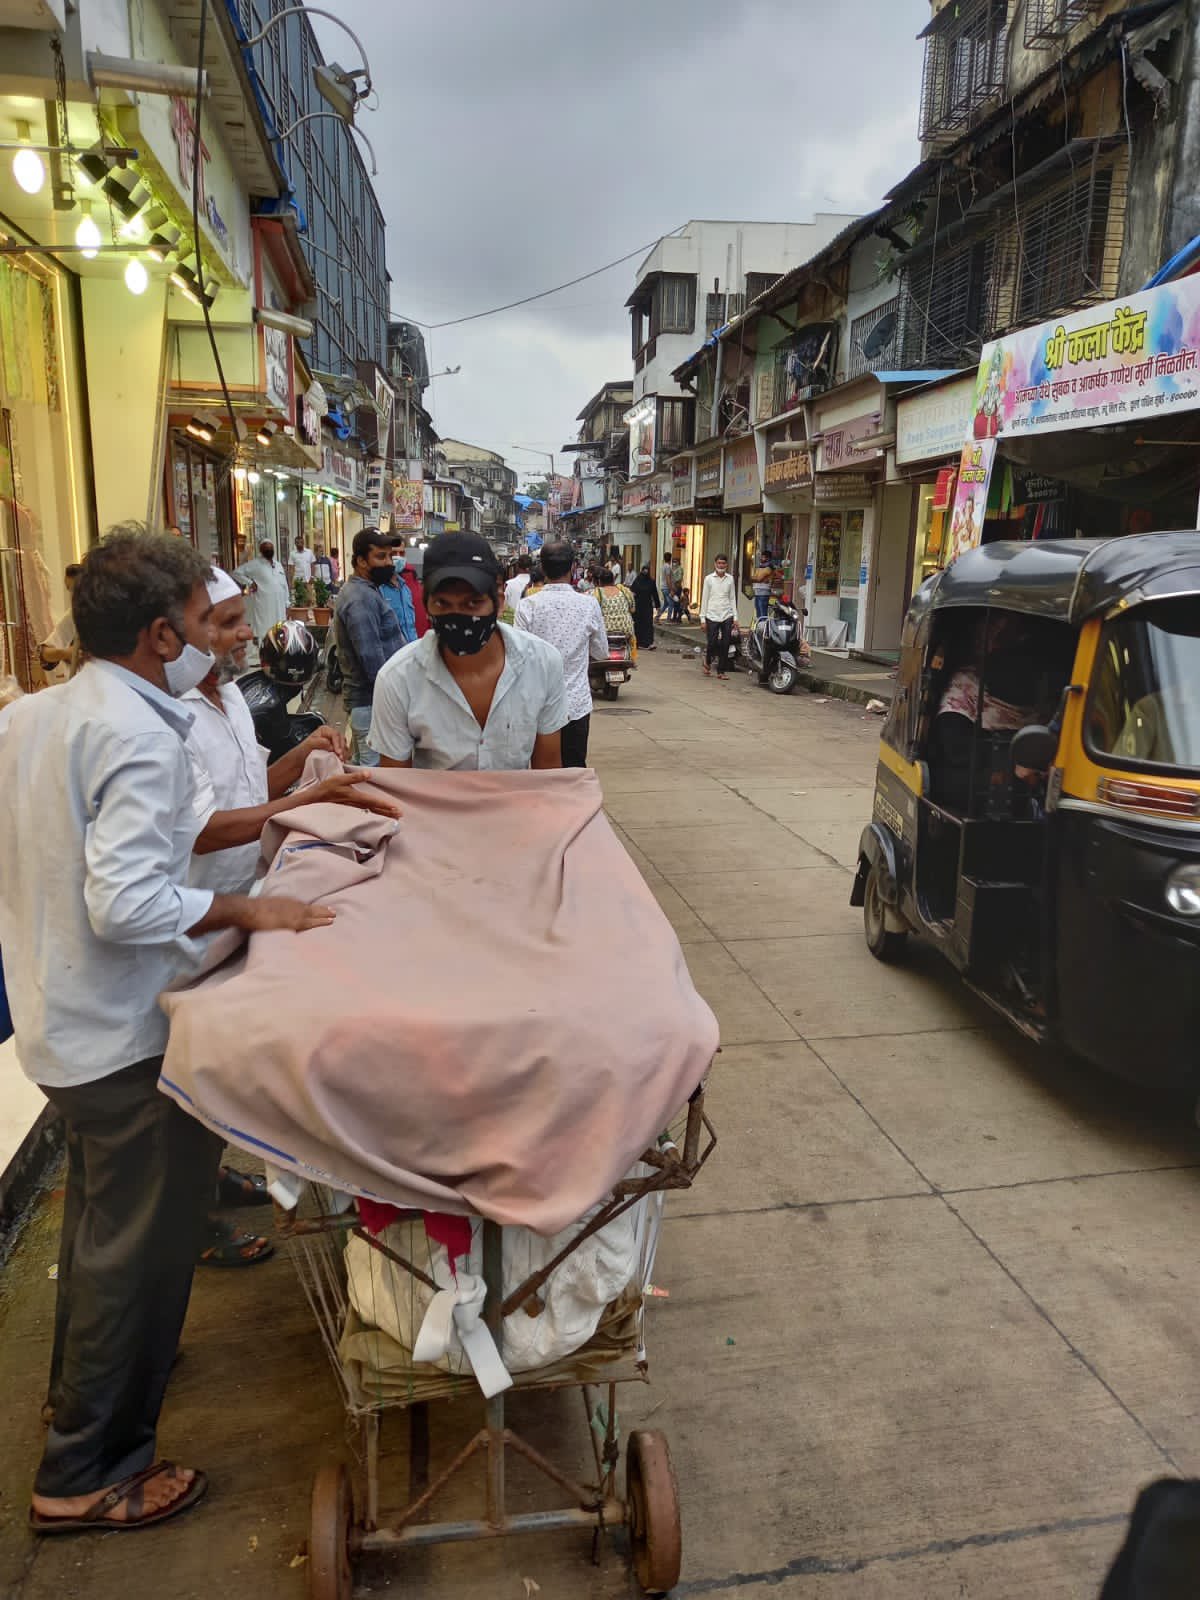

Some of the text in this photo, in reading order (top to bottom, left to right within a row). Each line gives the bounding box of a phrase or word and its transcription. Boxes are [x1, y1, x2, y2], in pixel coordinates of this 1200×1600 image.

[1045, 306, 1147, 369] श्री कला केंद्र
[1079, 367, 1109, 392] आकर्षक
[1110, 361, 1133, 386] गणेश
